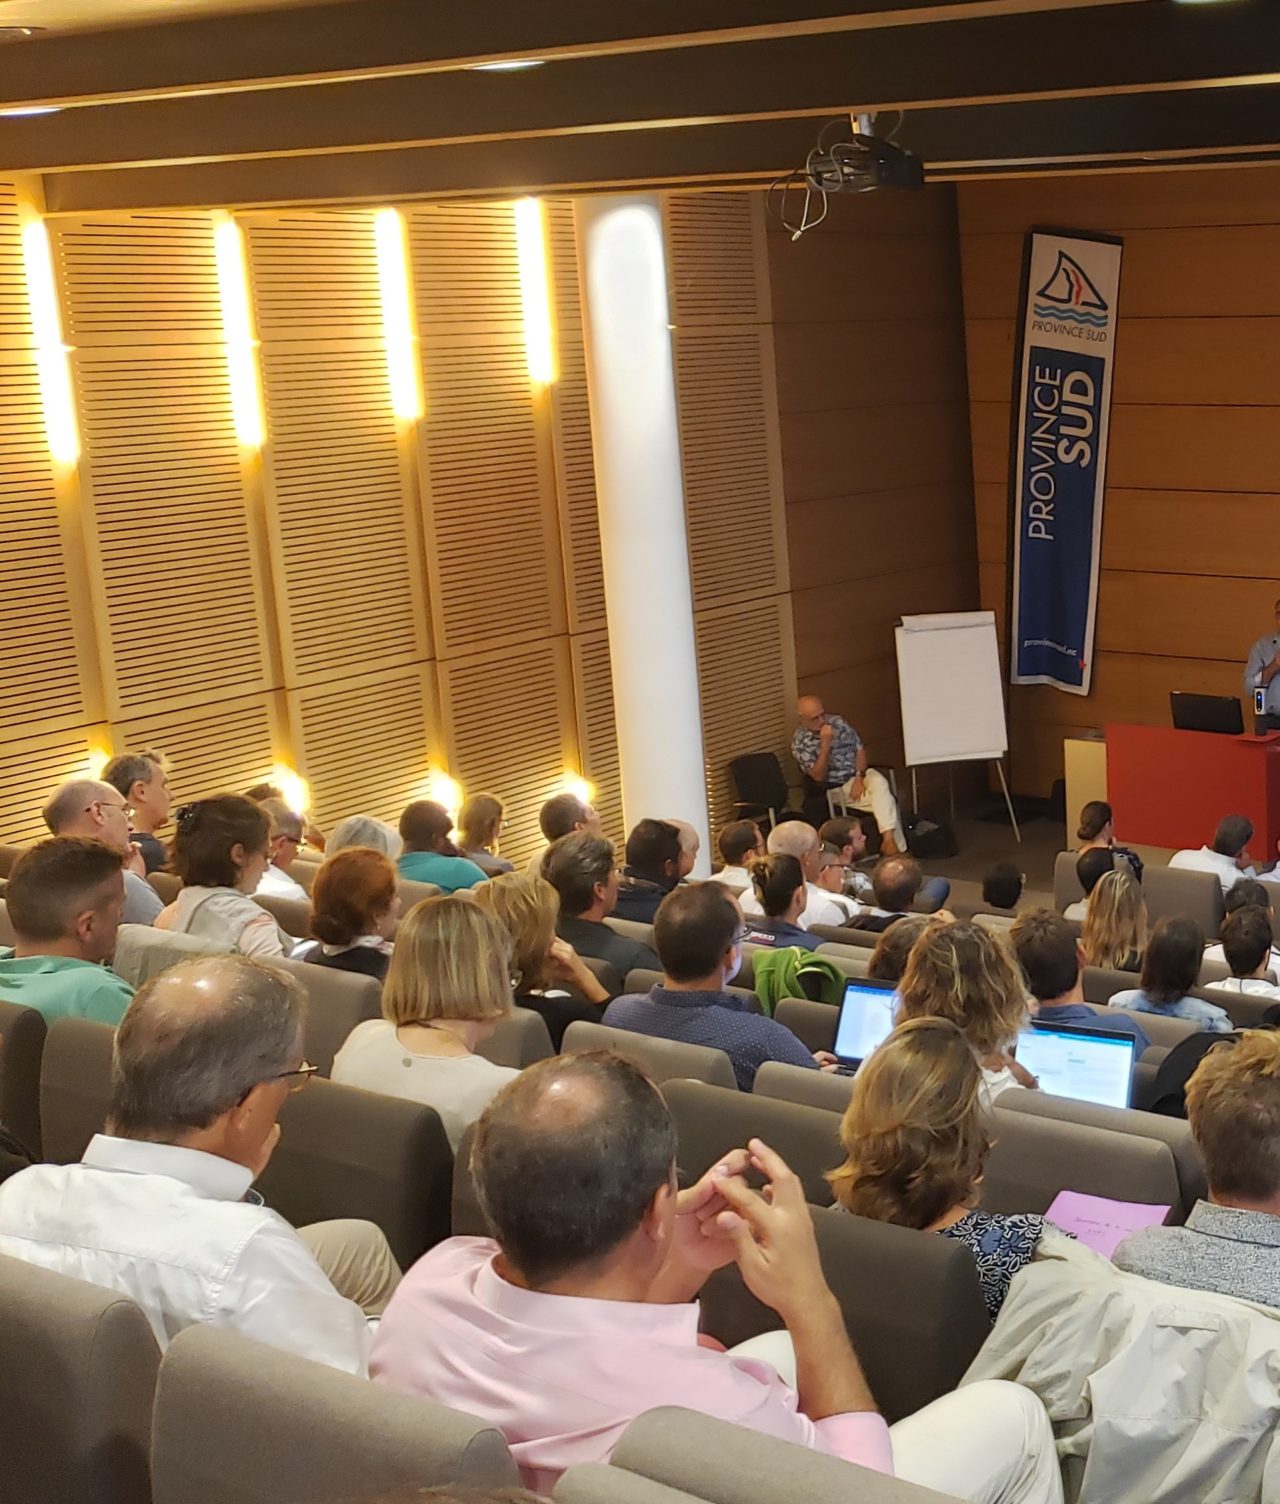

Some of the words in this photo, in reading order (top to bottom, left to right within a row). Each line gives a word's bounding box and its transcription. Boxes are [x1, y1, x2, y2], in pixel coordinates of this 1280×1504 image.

[1031, 320, 1084, 339] PROVINCE
[1086, 329, 1107, 343] SUD
[1028, 364, 1062, 540] PROVINCE
[1056, 370, 1095, 469] SUD
